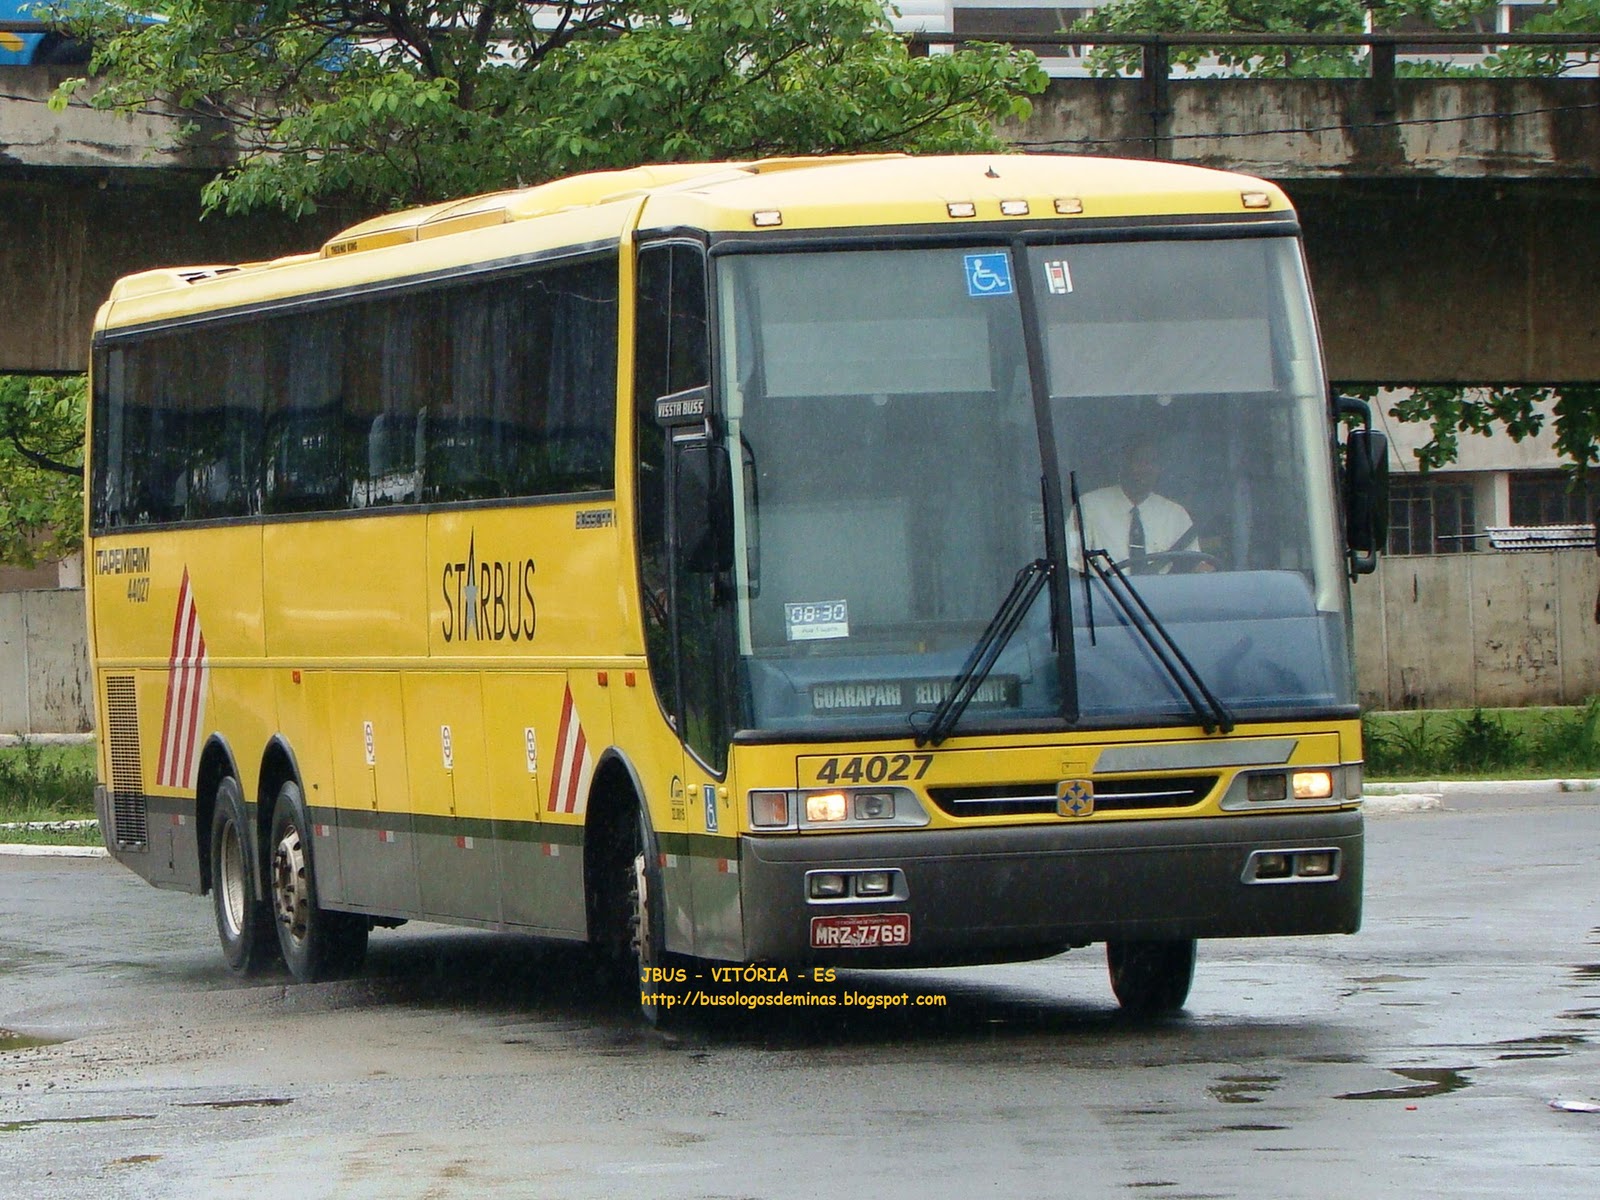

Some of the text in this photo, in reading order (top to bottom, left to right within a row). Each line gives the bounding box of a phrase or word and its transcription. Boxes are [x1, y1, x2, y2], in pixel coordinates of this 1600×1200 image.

[682, 399, 704, 415] BUSS
[442, 525, 536, 643] STARBUS
[790, 603, 845, 623] 08:30
[816, 754, 934, 784] 44027
